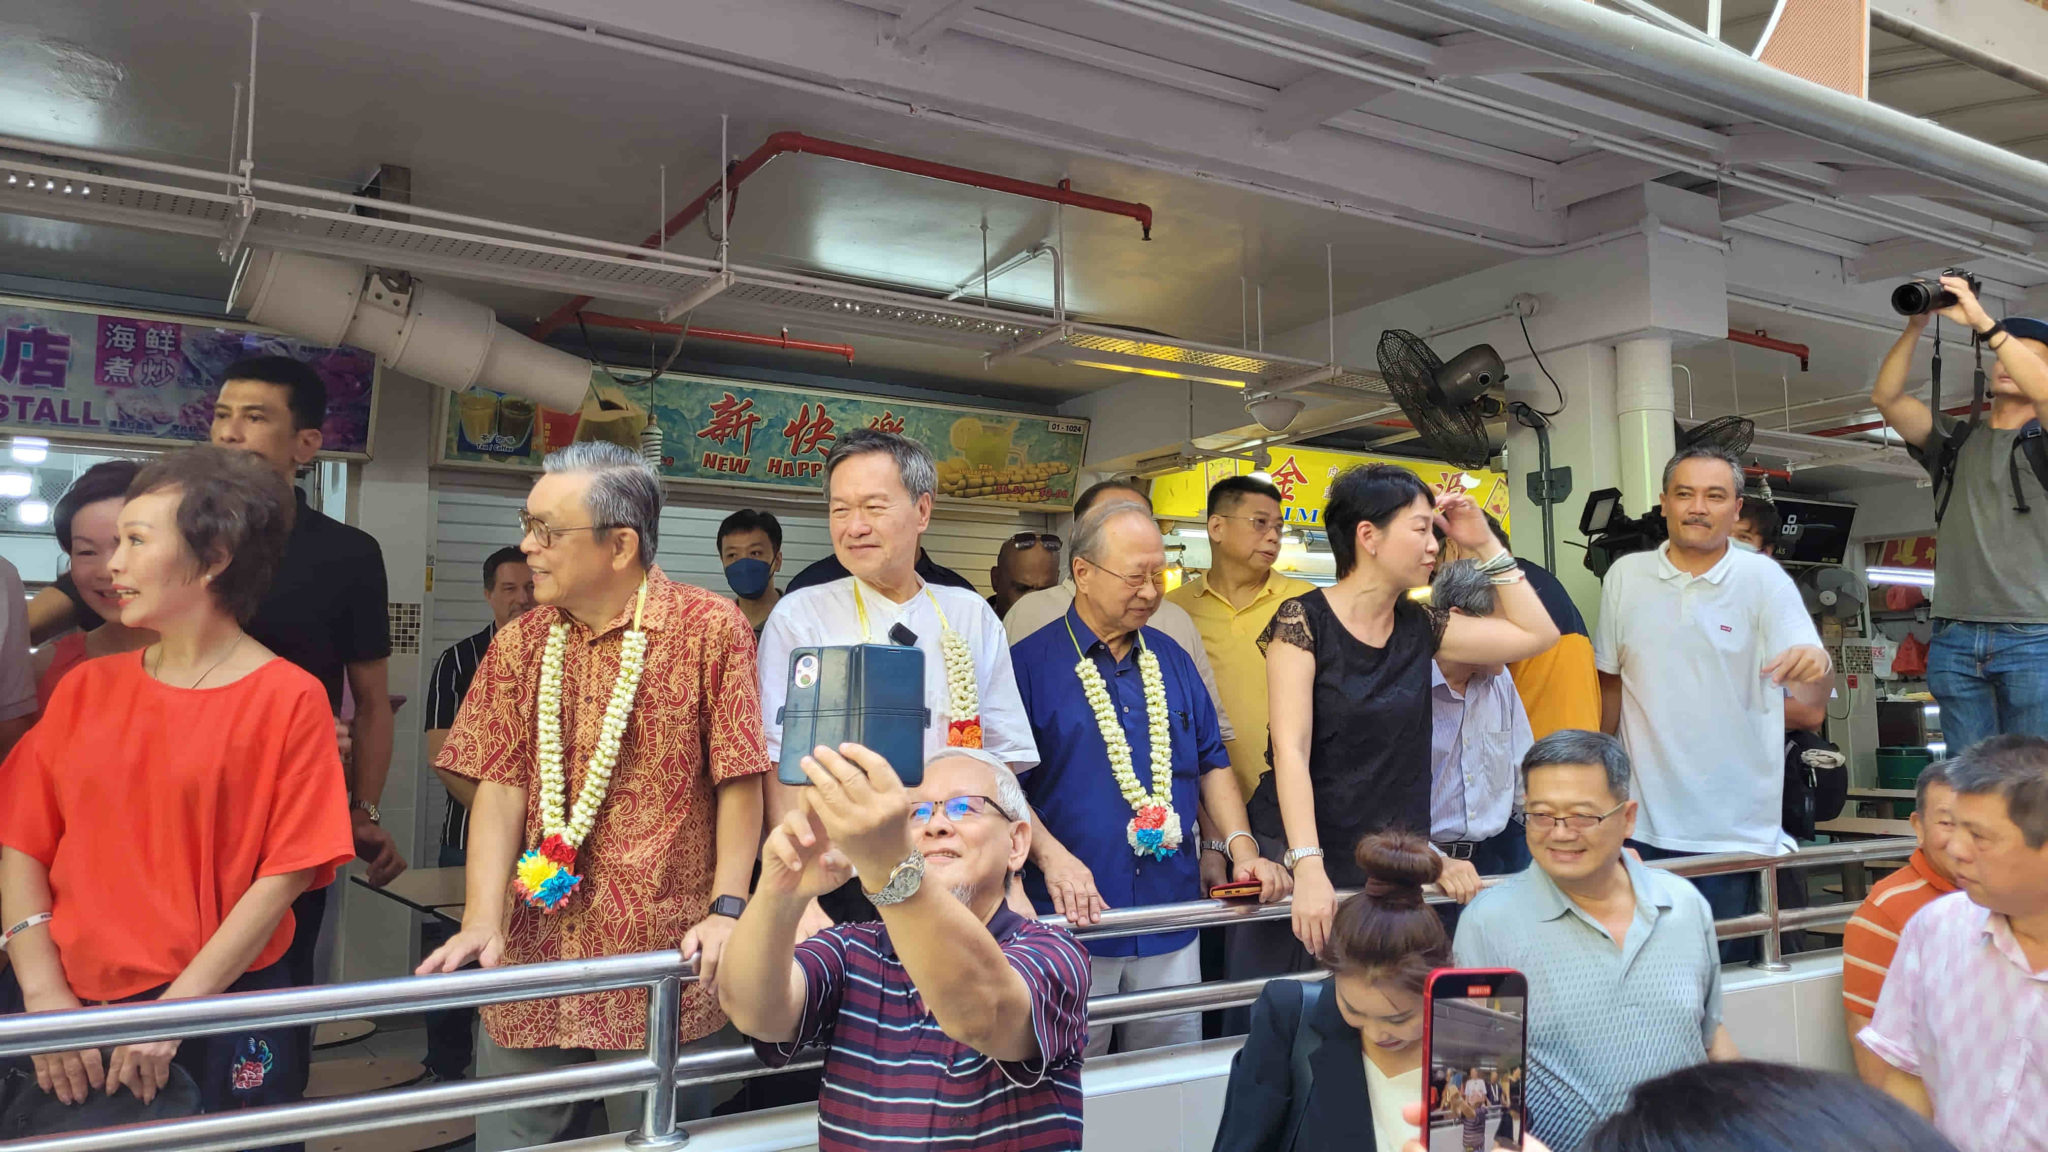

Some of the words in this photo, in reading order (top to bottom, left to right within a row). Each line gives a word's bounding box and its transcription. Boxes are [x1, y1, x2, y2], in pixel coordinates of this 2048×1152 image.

[105, 322, 177, 356] 海鮮
[0, 326, 72, 390] 店
[103, 355, 174, 386] 煮炒
[702, 452, 751, 475] NEW
[766, 457, 825, 478] HAPP
[1271, 455, 1308, 502] 金
[1283, 506, 1321, 523] IM
